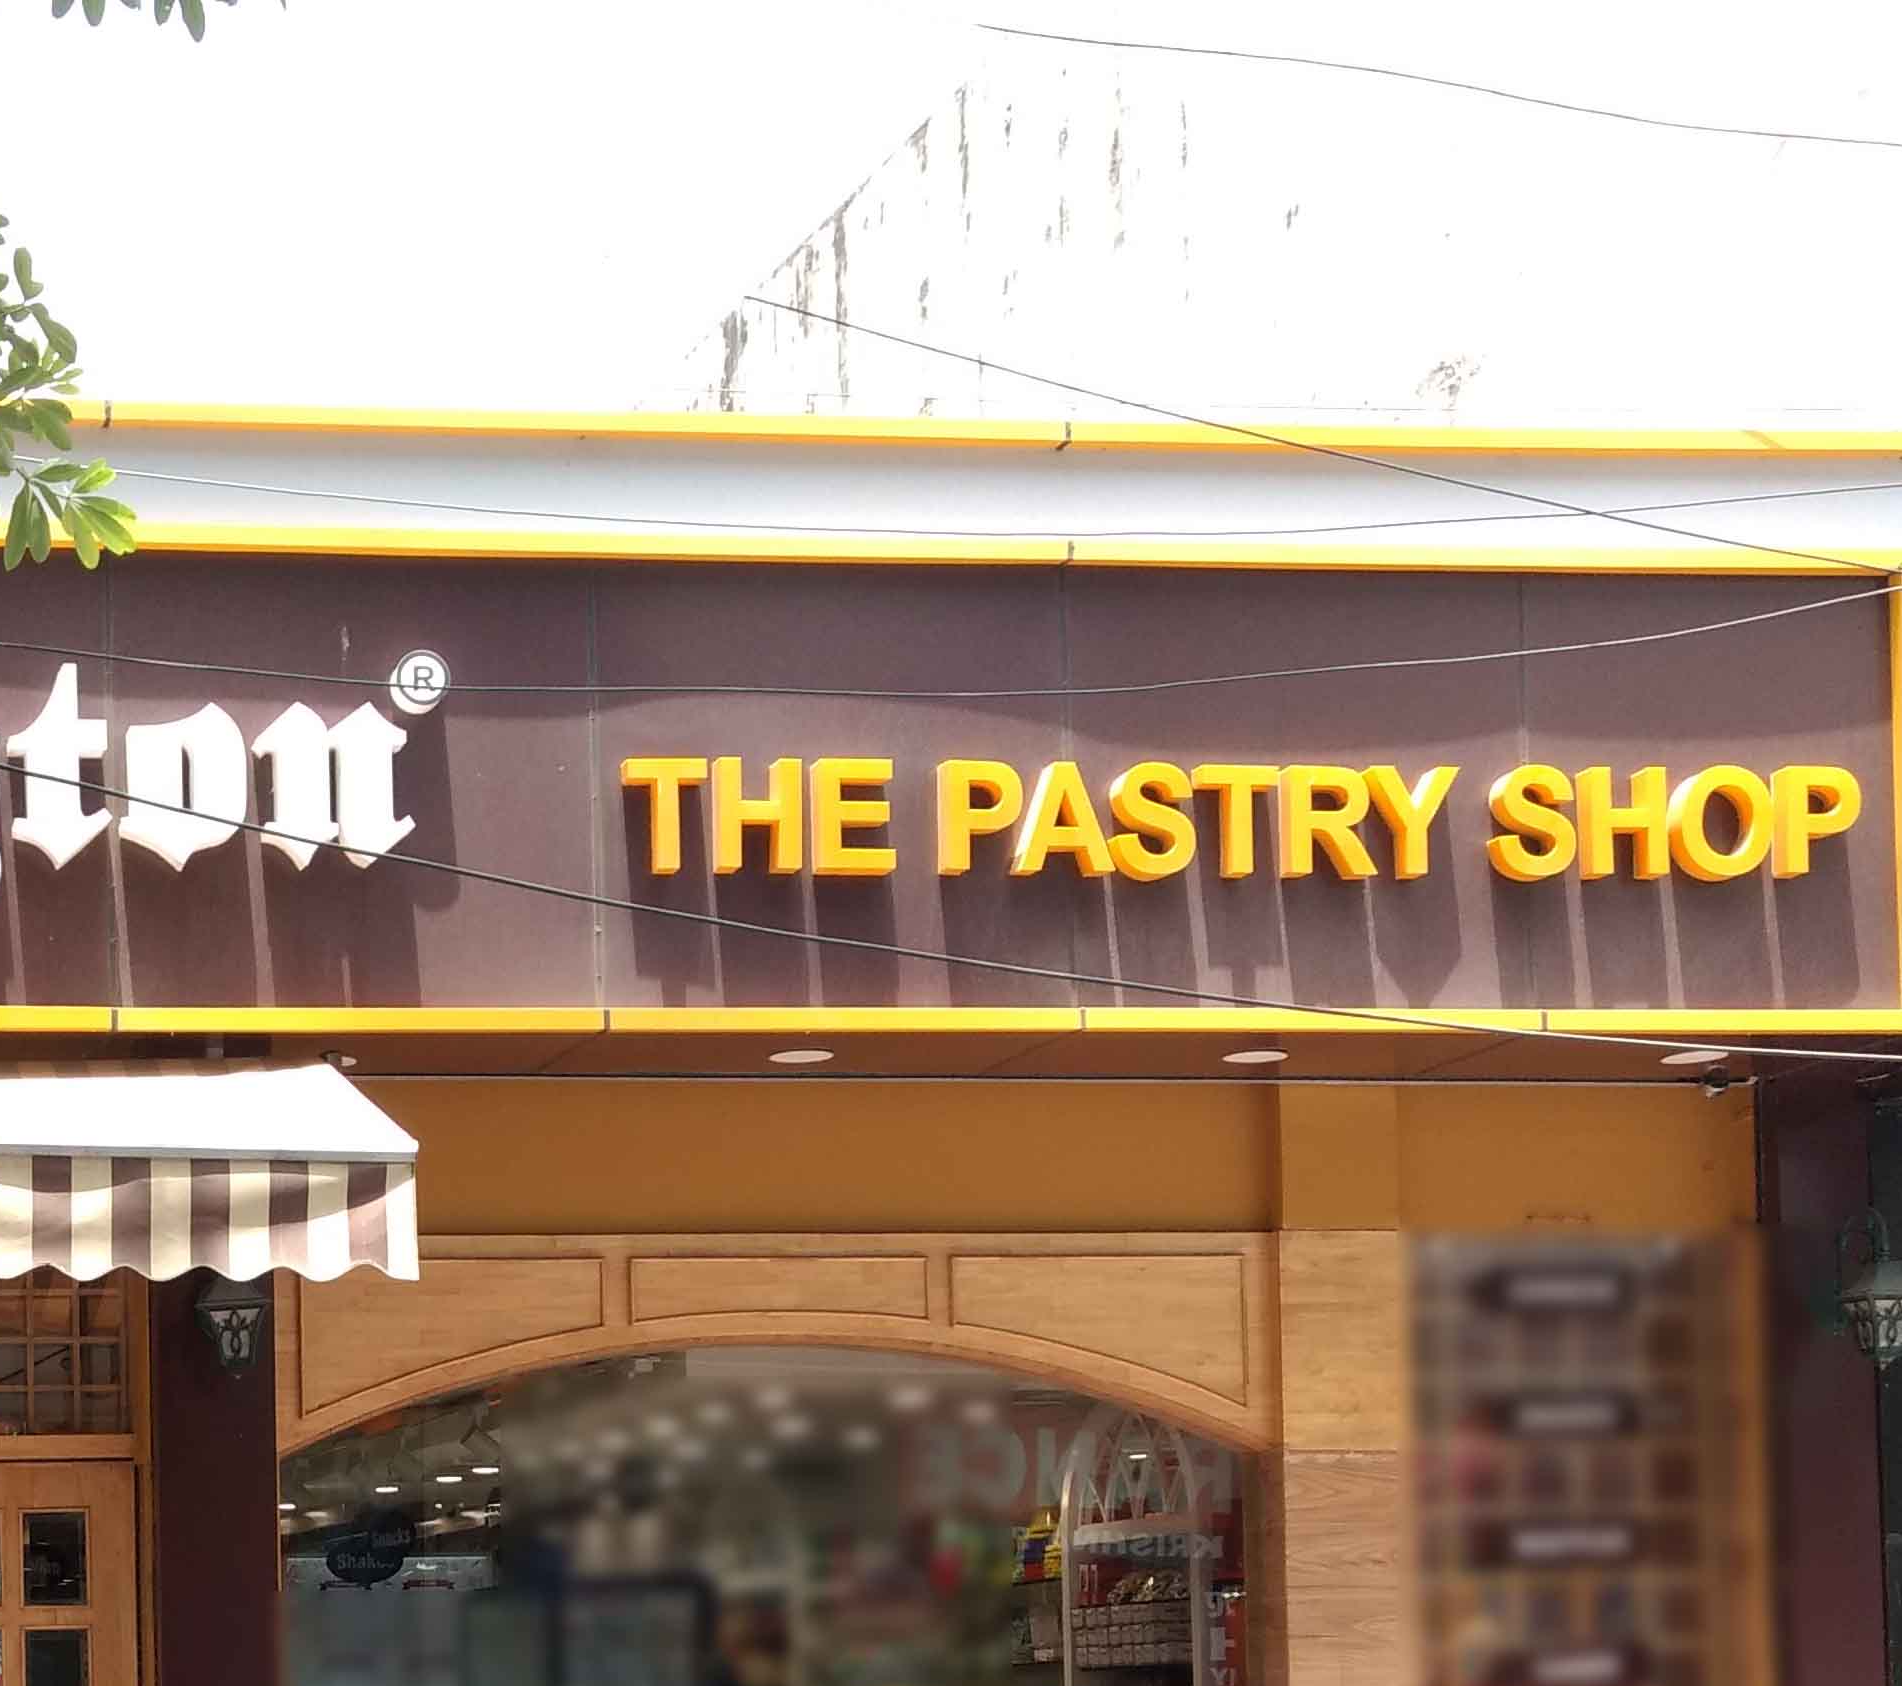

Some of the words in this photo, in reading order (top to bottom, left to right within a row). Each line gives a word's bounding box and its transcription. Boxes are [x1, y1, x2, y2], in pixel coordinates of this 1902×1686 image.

[620, 756, 897, 876] THE
[936, 759, 1461, 882] PASTRY
[1488, 762, 1862, 883] SHOP
